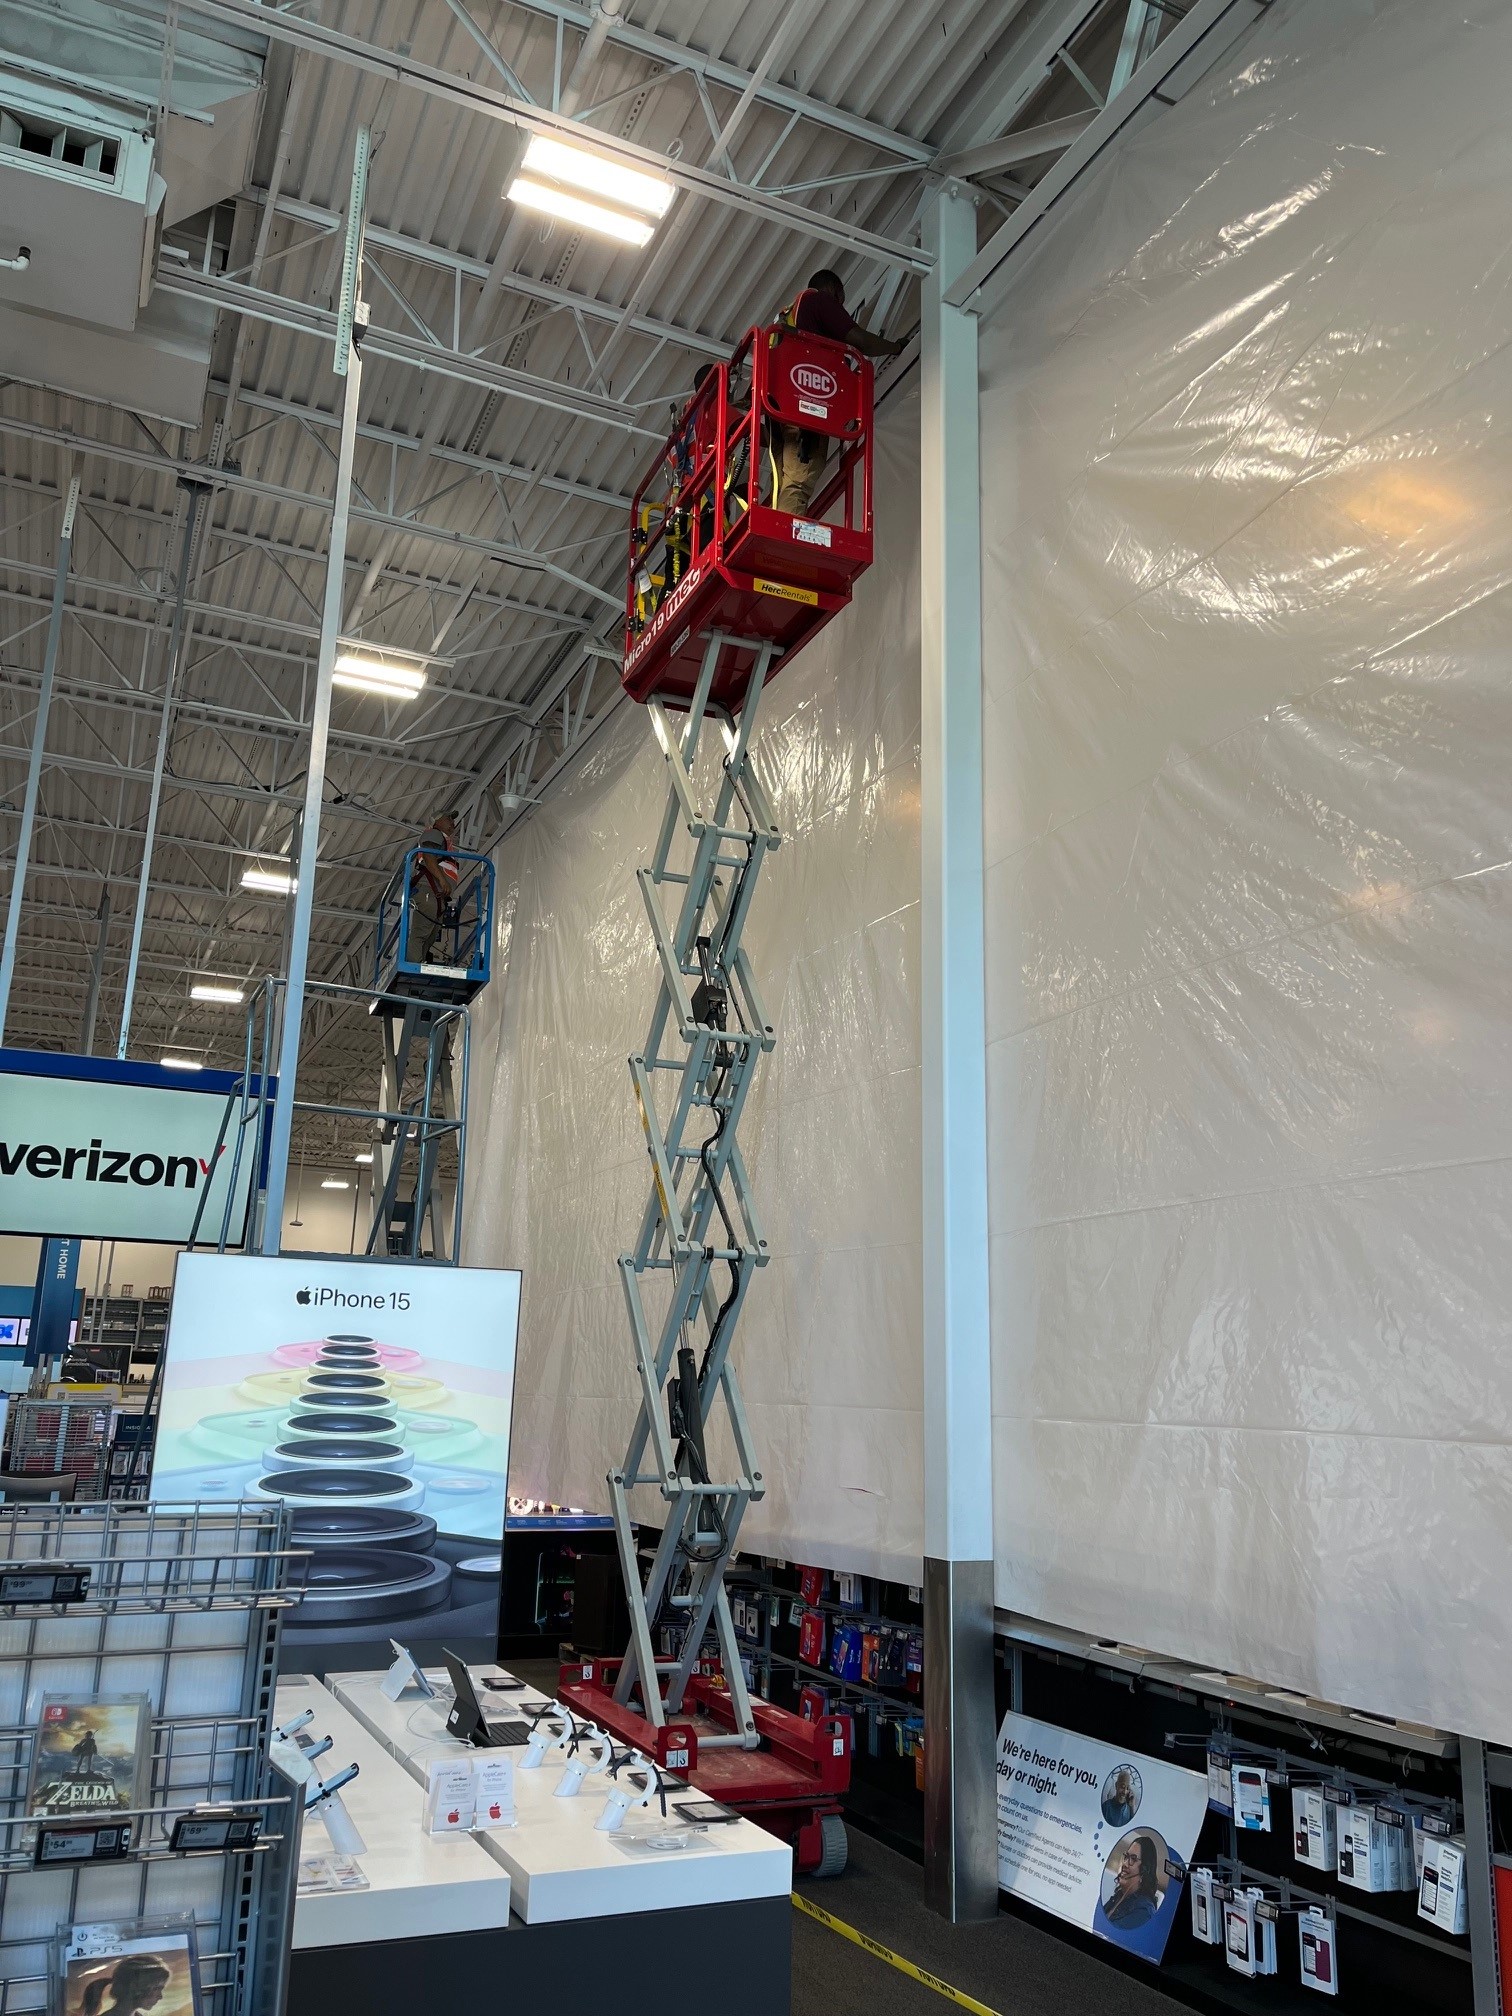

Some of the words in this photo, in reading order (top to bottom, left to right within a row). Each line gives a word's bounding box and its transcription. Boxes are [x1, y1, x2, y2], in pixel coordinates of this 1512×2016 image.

[761, 583, 810, 602] HercRentals
[0, 1138, 198, 1188] verizon
[56, 1249, 68, 1280] HOME
[314, 1288, 386, 1309] iPhone
[389, 1292, 410, 1310] 15
[1002, 1738, 1031, 1762] We're
[1032, 1749, 1056, 1770] here
[1058, 1758, 1074, 1778] for
[1074, 1768, 1098, 1790] you,
[996, 1760, 1015, 1780] day
[1015, 1770, 1027, 1782] or
[1027, 1774, 1057, 1796] night.
[46, 1782, 117, 1805] ZELDA
[999, 1794, 1020, 1808] everyday
[1020, 1802, 1044, 1816] questions
[1049, 1814, 1082, 1834] emergencies,
[1001, 1805, 1015, 1816] count
[90, 1945, 122, 1955] PS5
